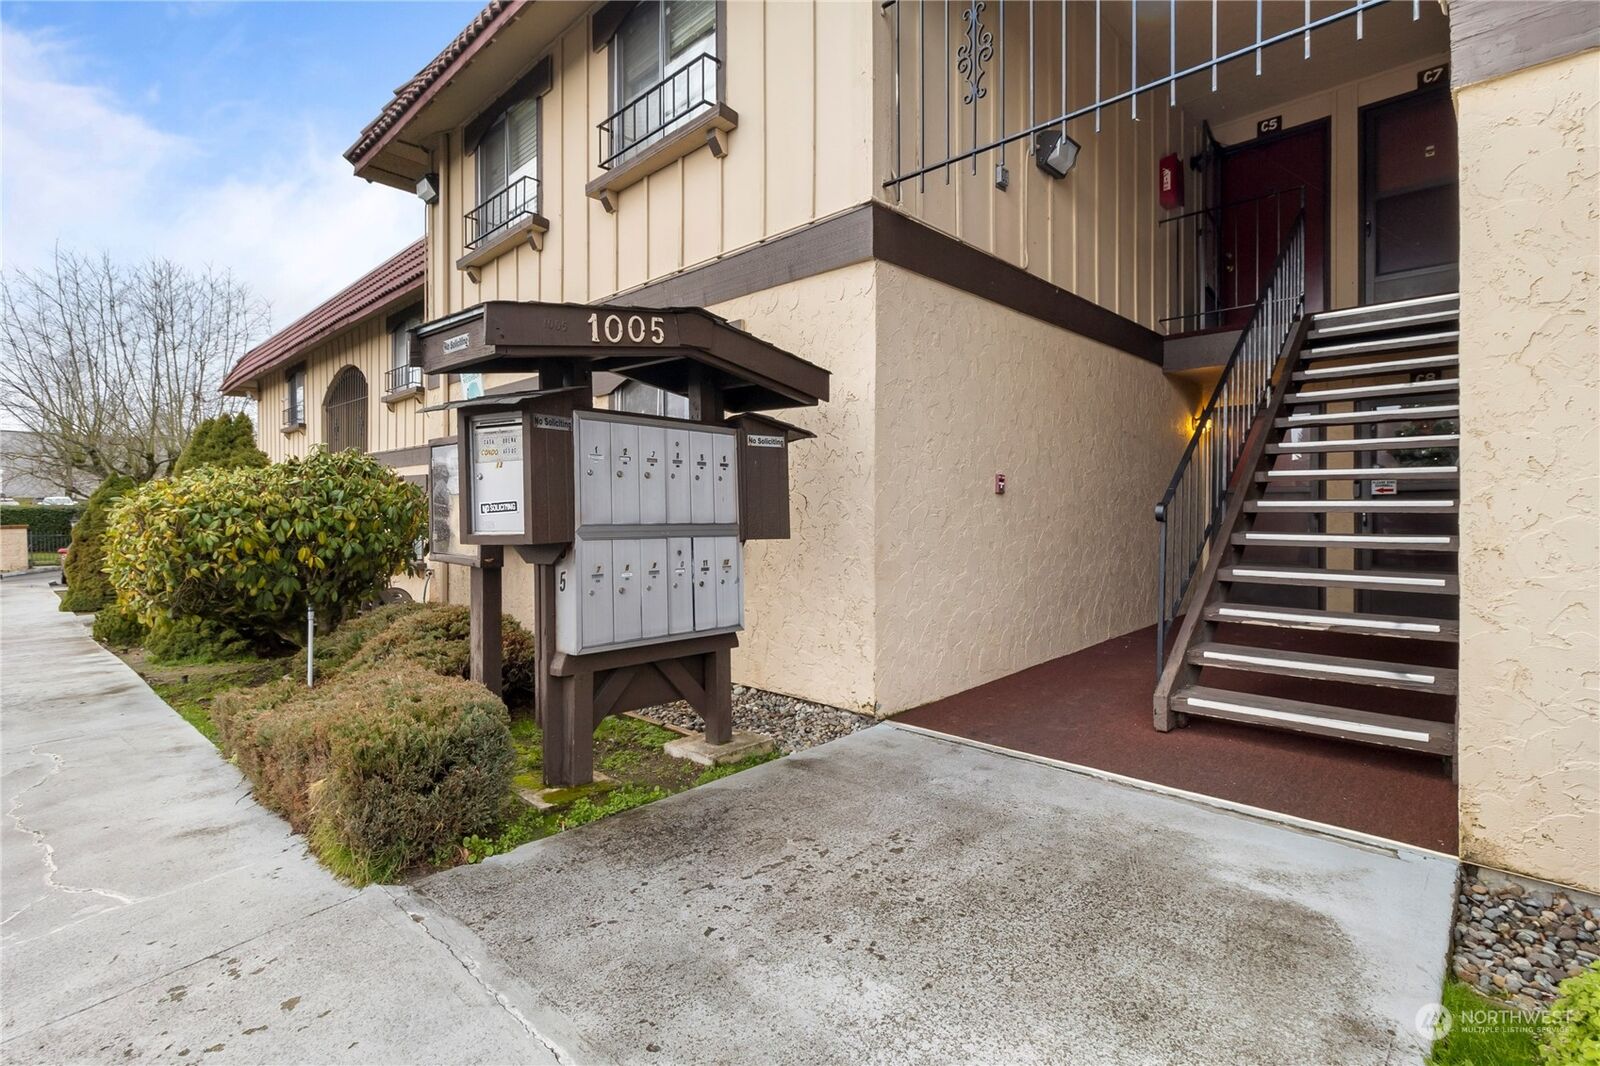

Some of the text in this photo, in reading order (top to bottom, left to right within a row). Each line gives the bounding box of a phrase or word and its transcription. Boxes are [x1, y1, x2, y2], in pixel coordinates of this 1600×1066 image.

[1423, 68, 1443, 83] C7
[1261, 118, 1278, 132] C5
[587, 313, 665, 344] 1005
[534, 415, 572, 429] No Soliciting
[748, 435, 784, 448] No Soliciting
[482, 502, 516, 512] NO SOLICITING
[560, 571, 567, 592] 5
